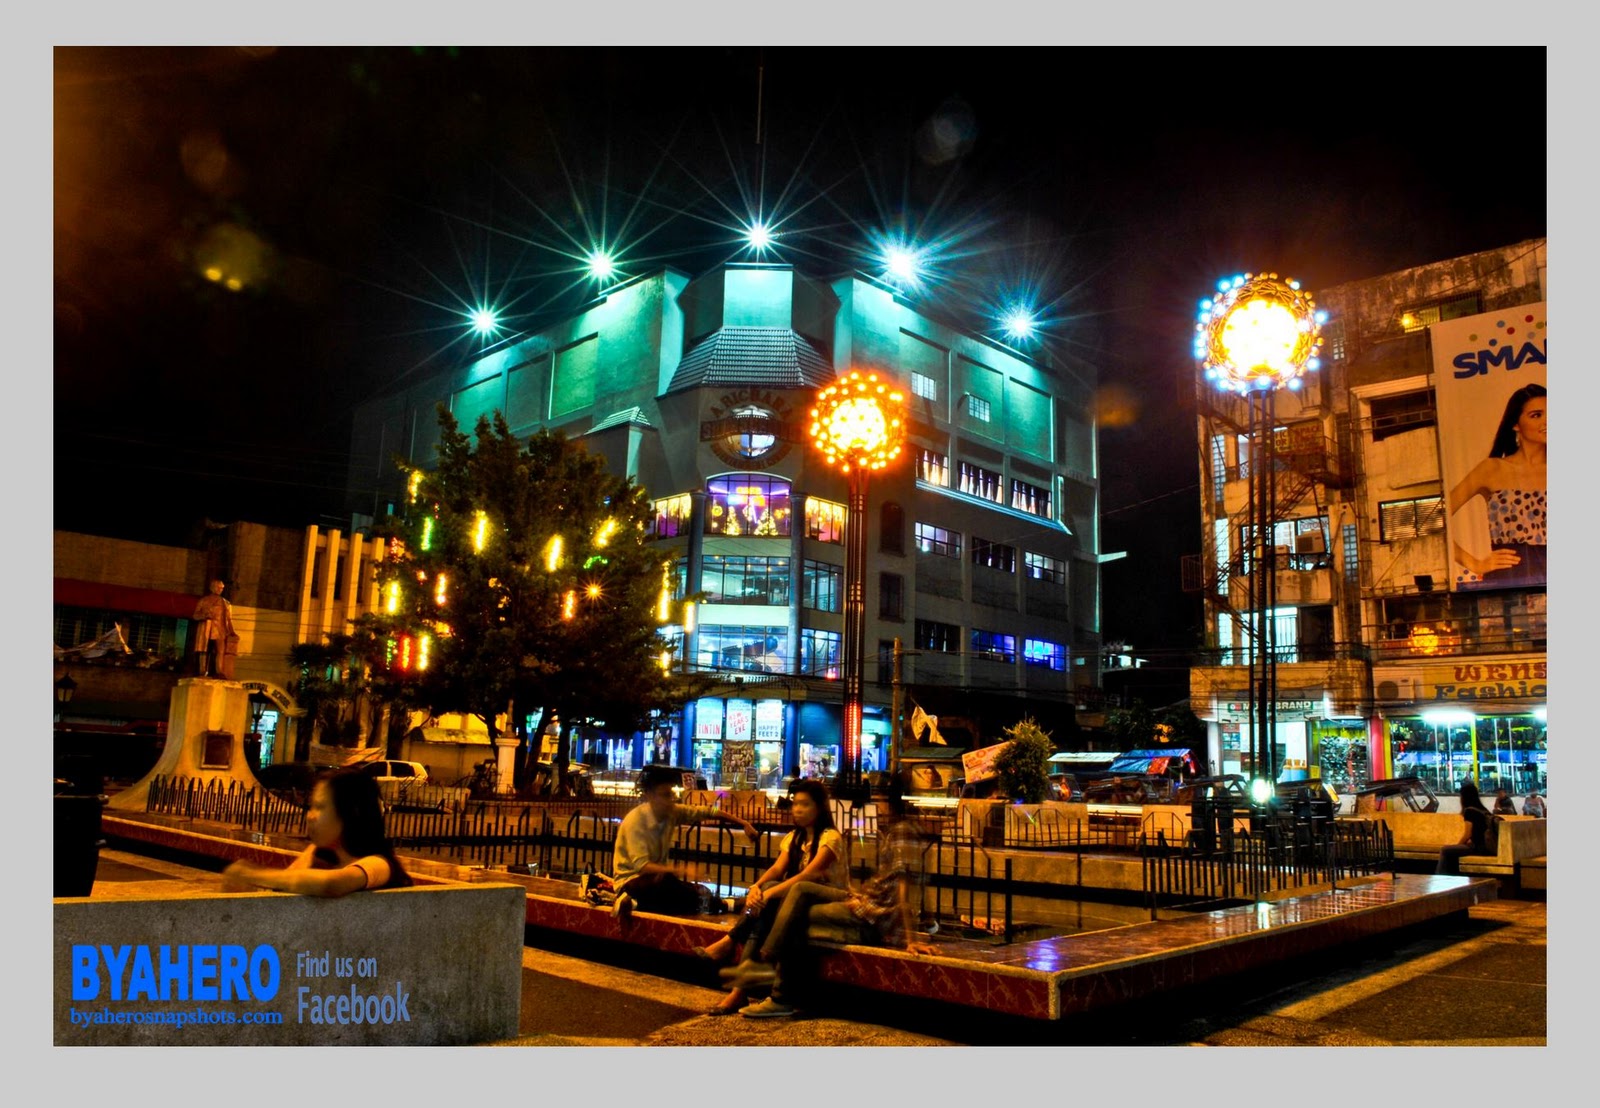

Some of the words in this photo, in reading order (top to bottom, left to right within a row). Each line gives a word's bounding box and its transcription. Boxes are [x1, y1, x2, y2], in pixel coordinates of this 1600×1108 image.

[1453, 339, 1547, 379] SMA
[1275, 702, 1311, 710] BRAND
[698, 724, 720, 734] TINTIN
